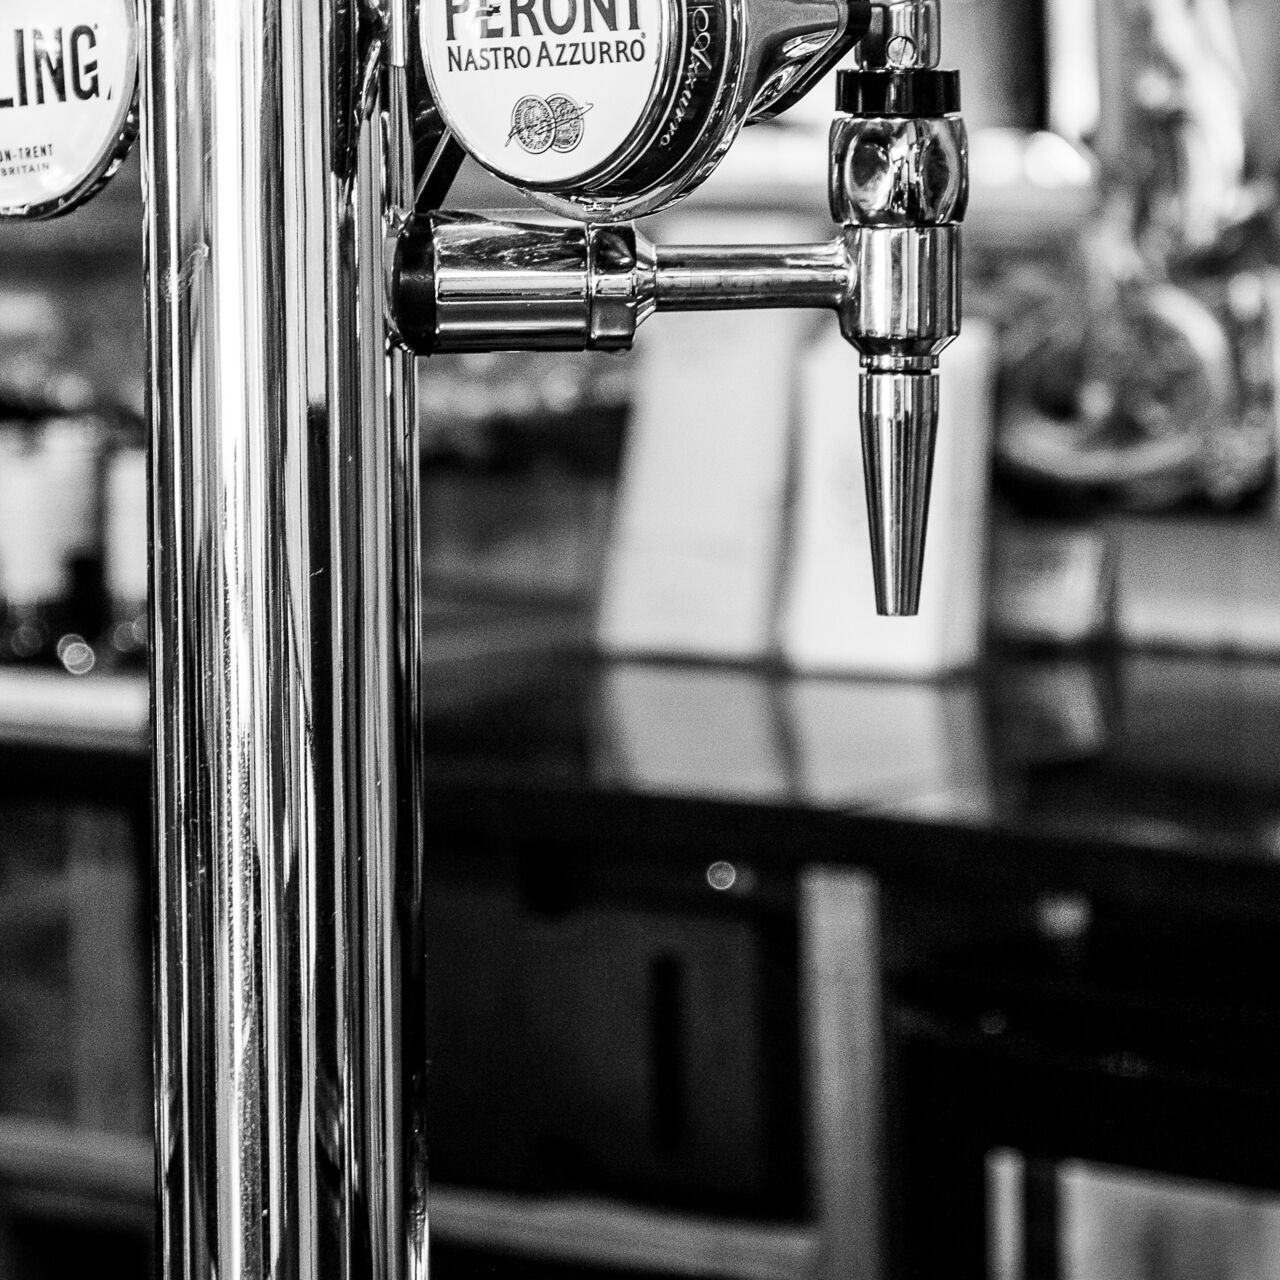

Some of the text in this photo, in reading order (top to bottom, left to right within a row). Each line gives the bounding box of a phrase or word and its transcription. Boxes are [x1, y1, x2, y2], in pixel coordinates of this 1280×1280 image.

[447, 39, 646, 72] NASTRO AZZURRO
[0, 162, 50, 177] BRITAIN
